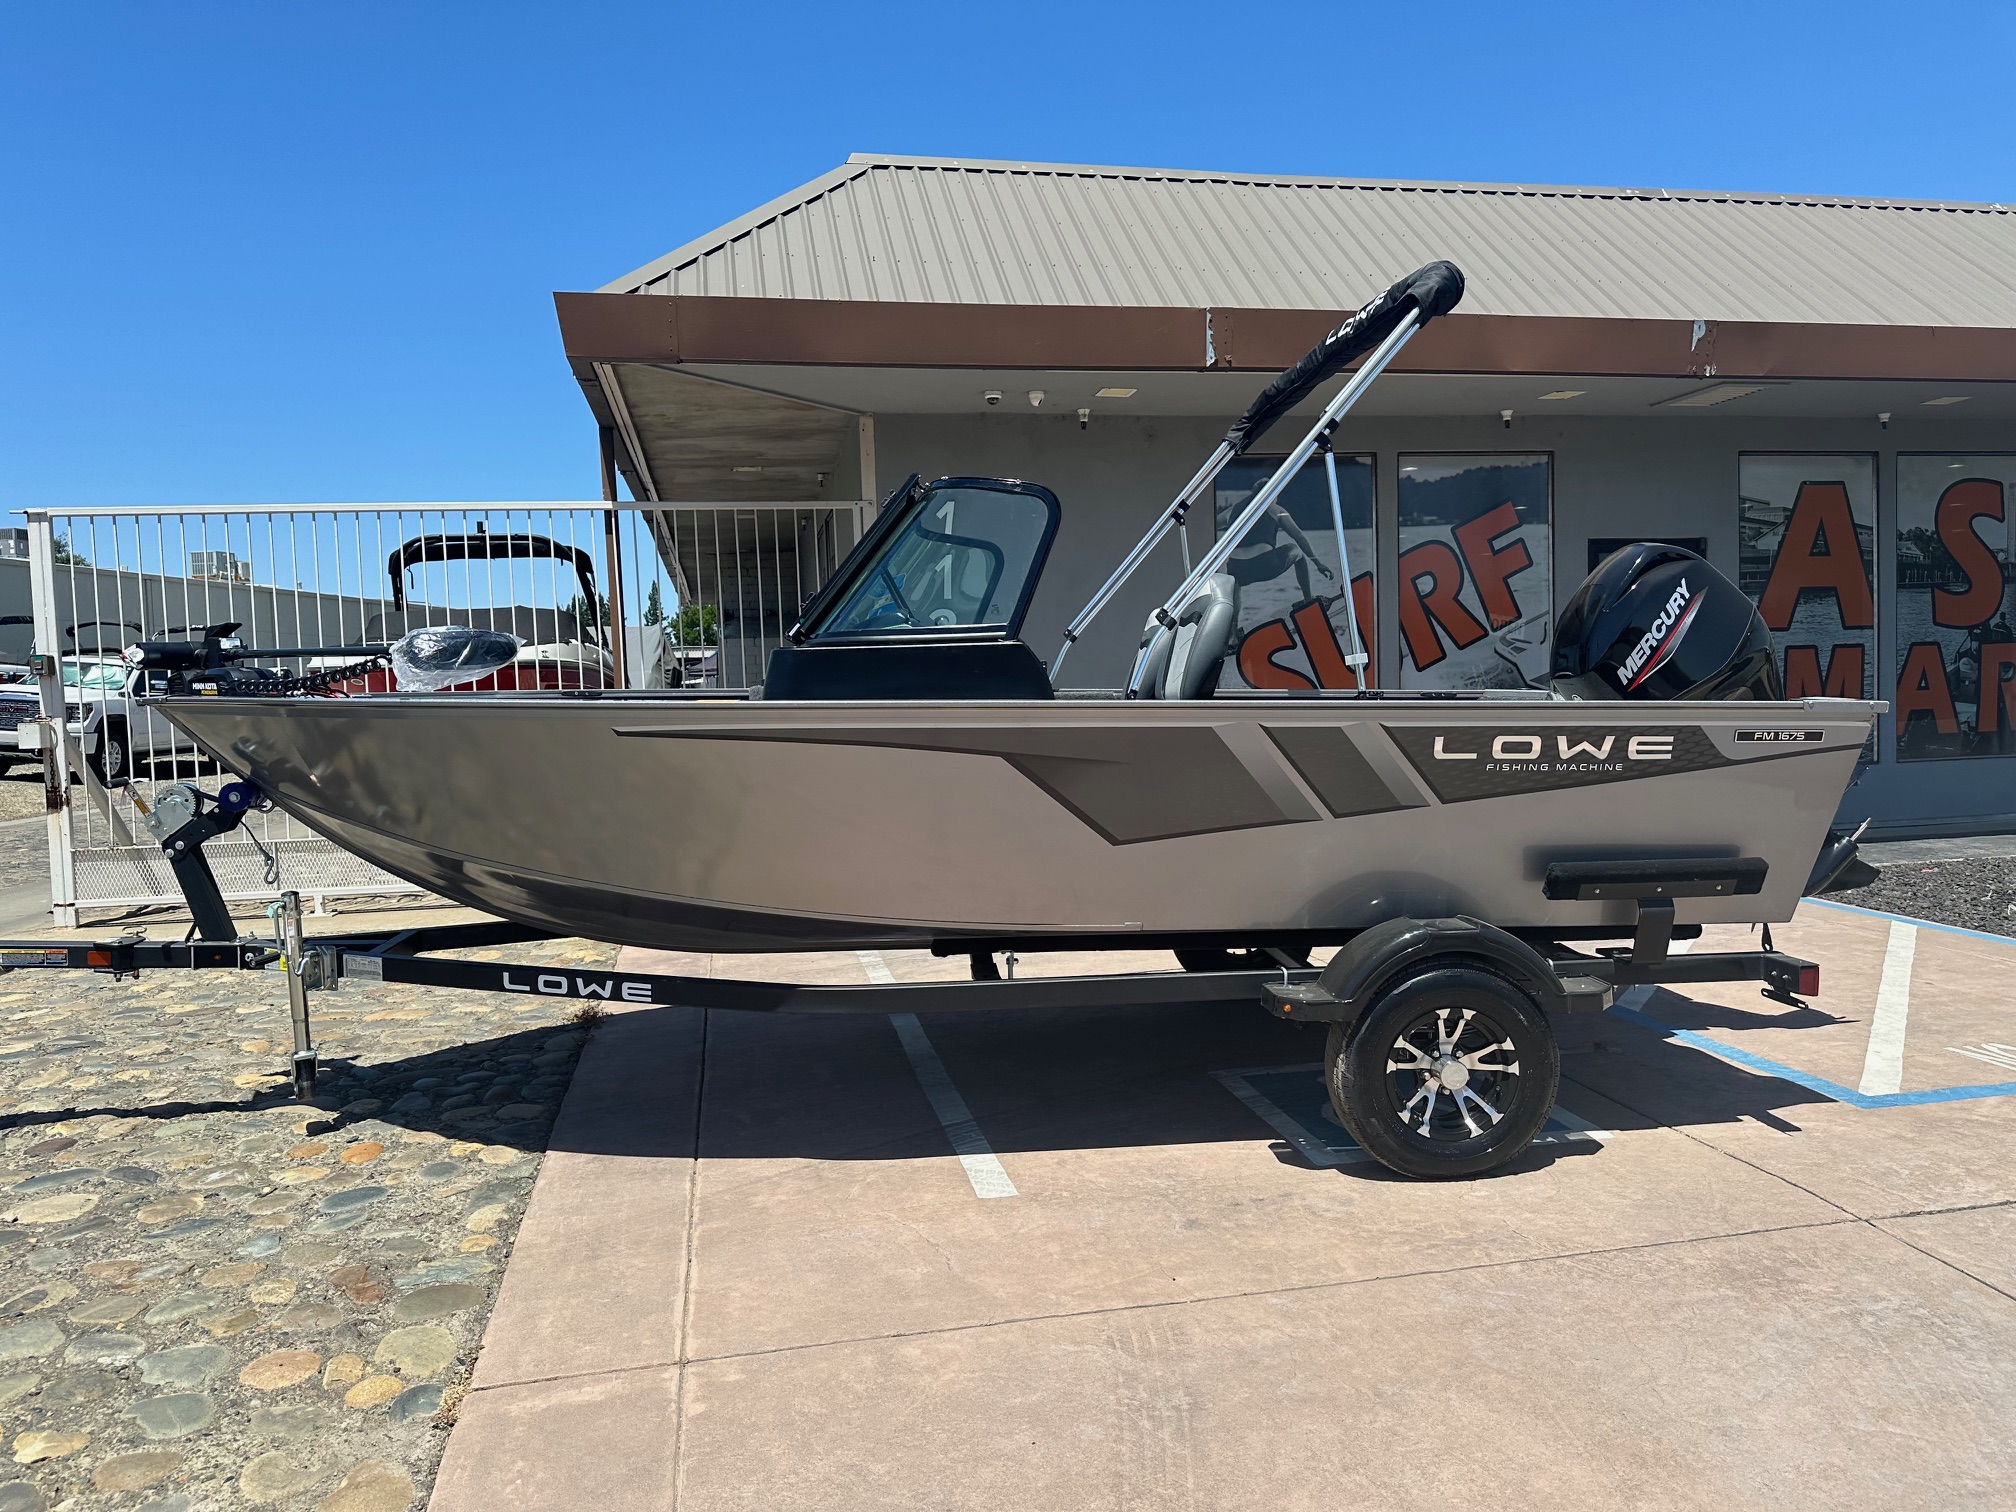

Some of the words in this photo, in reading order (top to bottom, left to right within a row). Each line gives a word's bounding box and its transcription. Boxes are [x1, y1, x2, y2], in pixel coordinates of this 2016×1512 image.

[1236, 500, 1533, 690] SURF
[1616, 577, 1690, 686] MERCURY
[1433, 735, 1675, 760] LOWE
[1754, 732, 1775, 741] FM
[1778, 732, 1805, 741] 1675
[1486, 763, 1549, 771] FISHING
[1556, 763, 1624, 771] MACHINE
[502, 971, 652, 1003] LOWE
